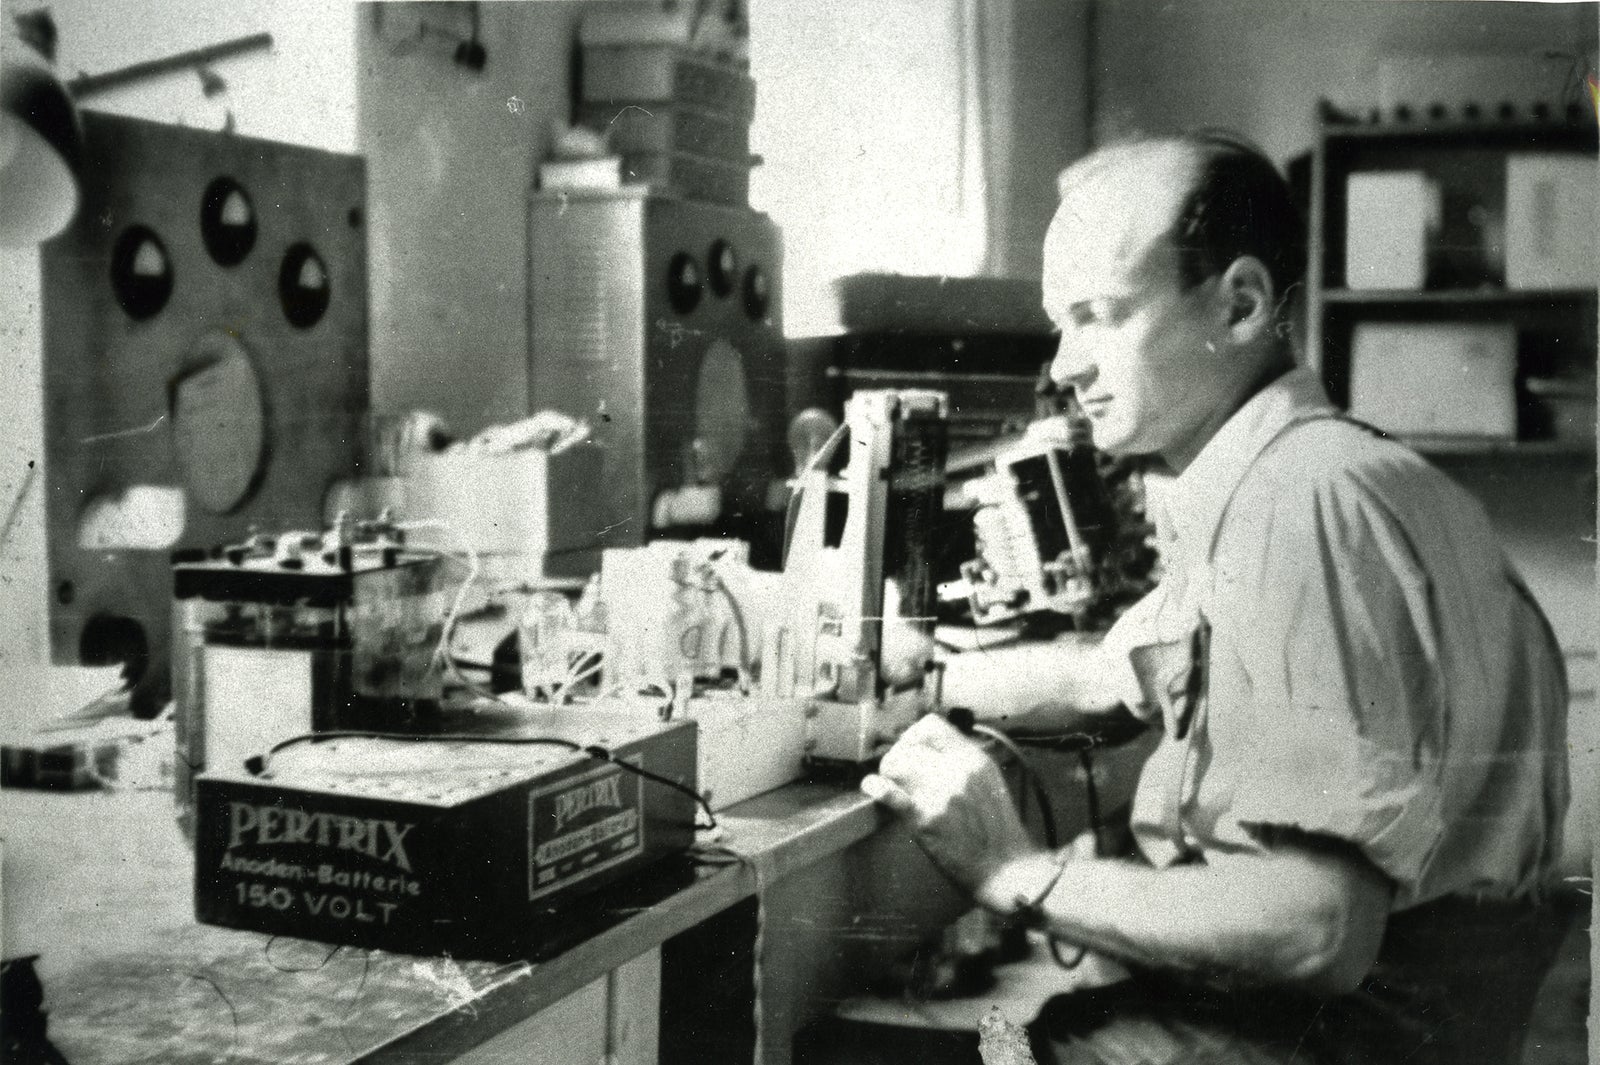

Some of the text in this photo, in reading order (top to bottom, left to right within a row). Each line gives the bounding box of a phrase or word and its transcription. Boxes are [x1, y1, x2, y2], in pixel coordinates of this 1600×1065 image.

[228, 802, 416, 873] PERTRIX
[221, 851, 421, 896] Anoden-Batterie
[235, 882, 398, 925] 150 VOLT
